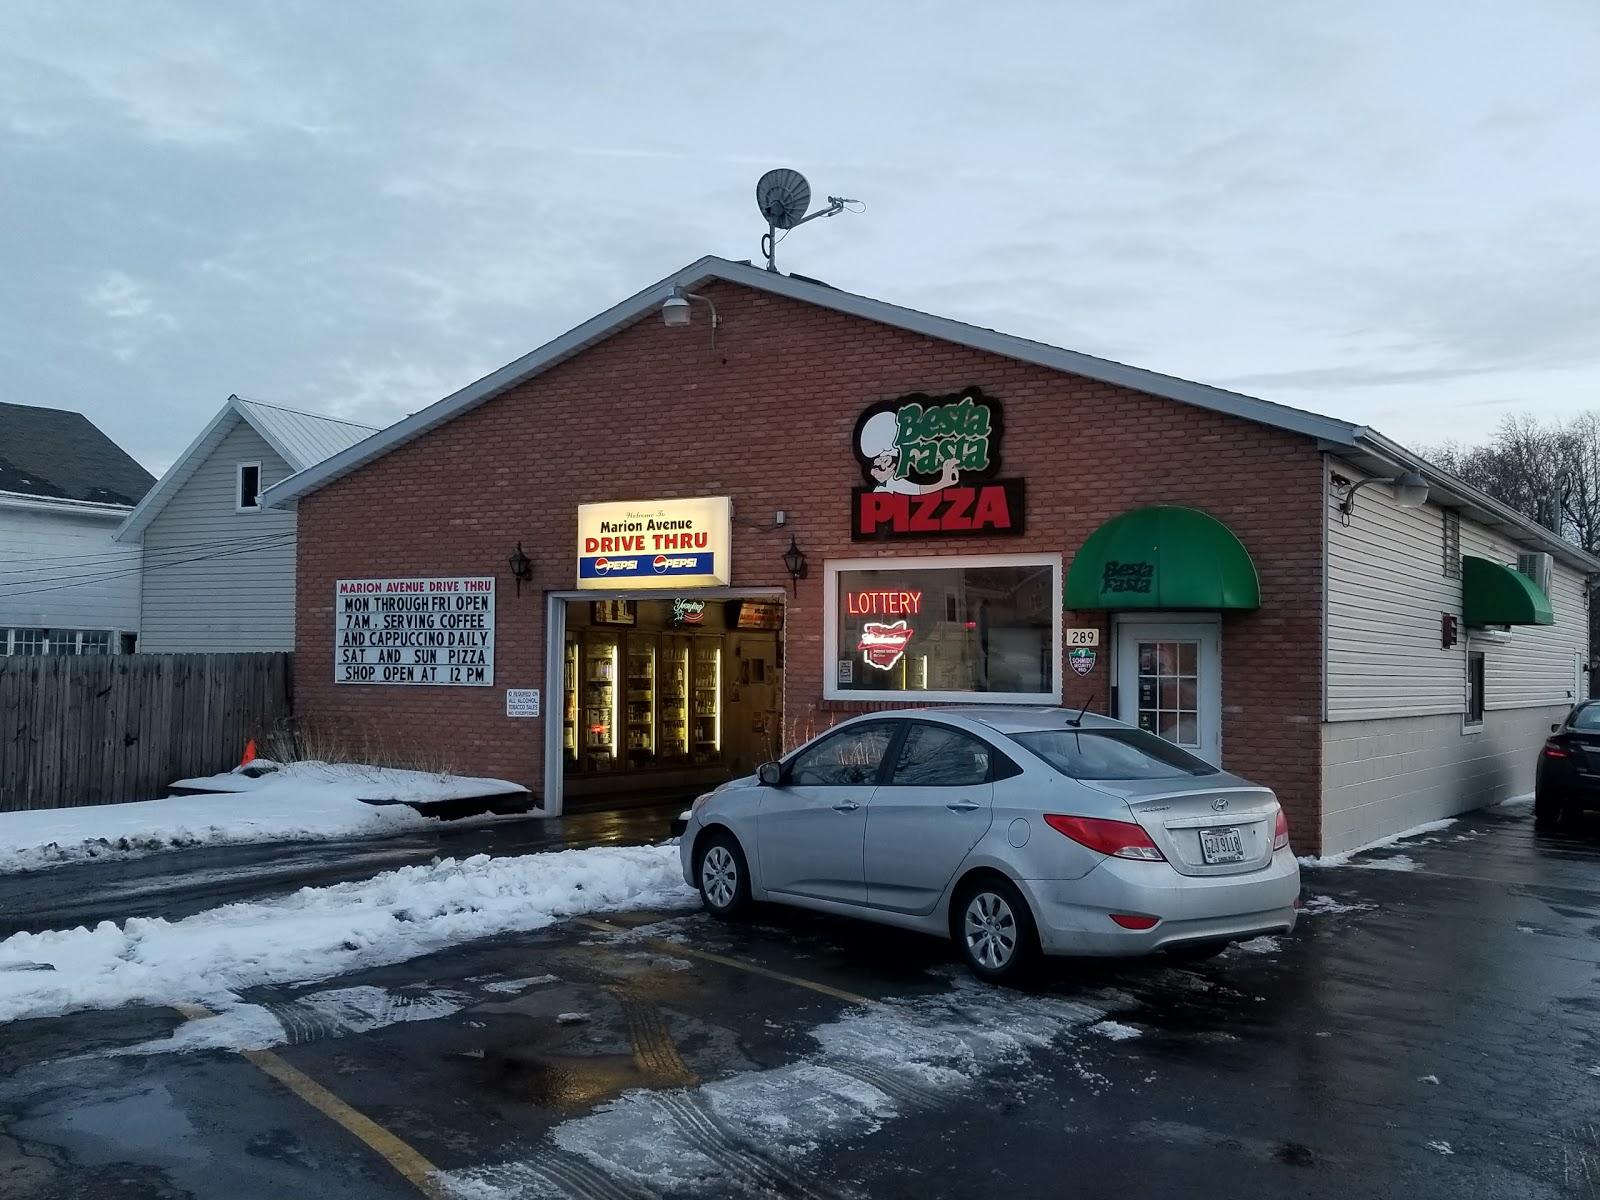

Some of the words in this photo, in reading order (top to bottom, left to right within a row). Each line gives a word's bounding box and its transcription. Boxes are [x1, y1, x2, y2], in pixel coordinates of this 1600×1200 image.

[895, 397, 991, 447] Besta
[894, 436, 990, 480] Fasta
[860, 486, 1011, 534] PIZZA
[600, 520, 643, 533] Marion
[646, 519, 693, 531] Avenue
[585, 535, 645, 553] DRIVE
[652, 532, 708, 550] THRU
[606, 560, 638, 570] PEPSI
[665, 557, 698, 568] PEPSI
[340, 582, 382, 593] MARION
[386, 581, 425, 592] AVENUE
[429, 581, 459, 592] DRIVE
[464, 580, 492, 591] THRU
[345, 597, 369, 611] MON
[374, 597, 429, 611] THROUGH
[432, 597, 451, 611] FRI
[456, 596, 488, 610] OPEN
[848, 592, 921, 614] LOTTERY
[383, 614, 435, 629] SERVING
[440, 614, 485, 628] COFFEE
[343, 632, 365, 646] AND
[369, 632, 445, 646] CAPPUCCINO
[448, 632, 488, 646] DAILY
[1072, 631, 1094, 644] 289
[343, 649, 366, 663] SAT
[378, 649, 401, 663] AND
[414, 649, 437, 664] SUN
[449, 649, 486, 664] PIZZA
[345, 666, 375, 680] SHOP
[383, 667, 414, 681] OPEN
[421, 667, 437, 681] AT
[450, 668, 461, 682] 12
[466, 668, 484, 682] PM
